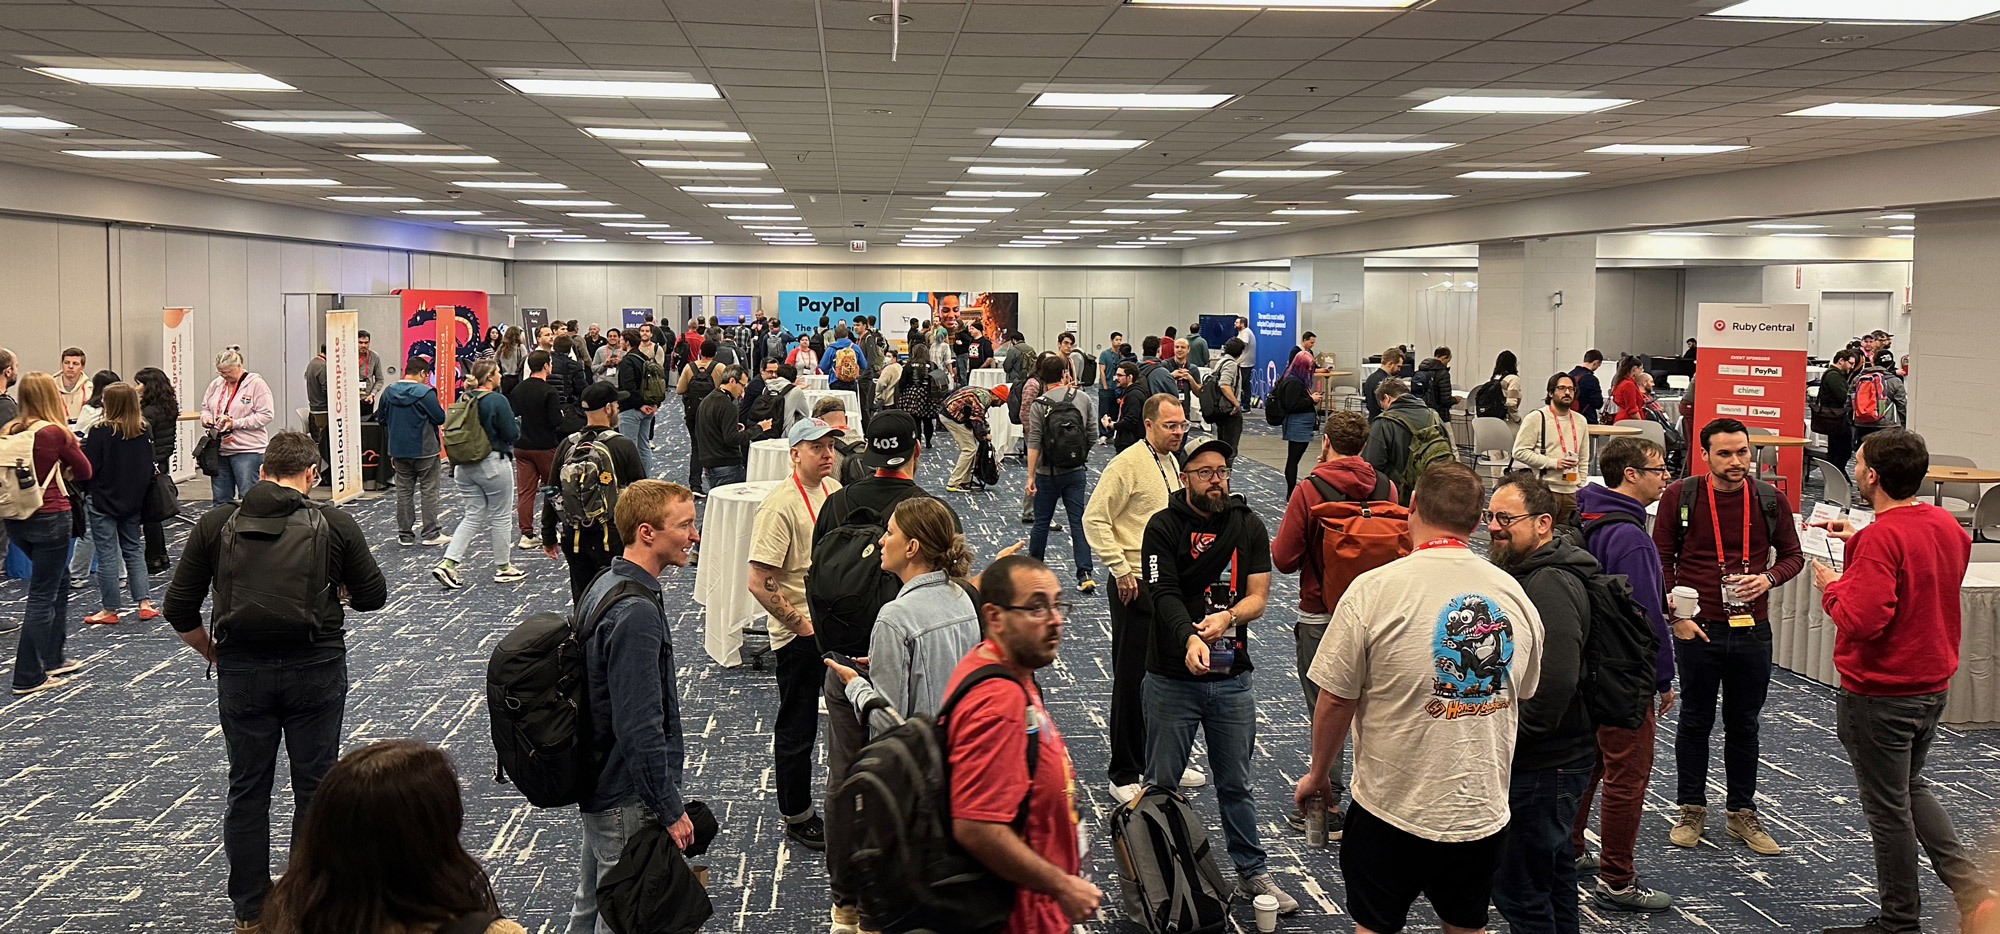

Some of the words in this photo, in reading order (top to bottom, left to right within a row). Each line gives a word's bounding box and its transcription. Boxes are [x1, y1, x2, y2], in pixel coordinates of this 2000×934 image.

[798, 296, 860, 315] PayPal
[795, 323, 812, 332] The
[1732, 322, 1757, 332] Ruby
[1758, 323, 1795, 332] Central
[1754, 367, 1778, 375] PayPal
[873, 436, 899, 450] 403
[336, 418, 345, 492] Ubicloud
